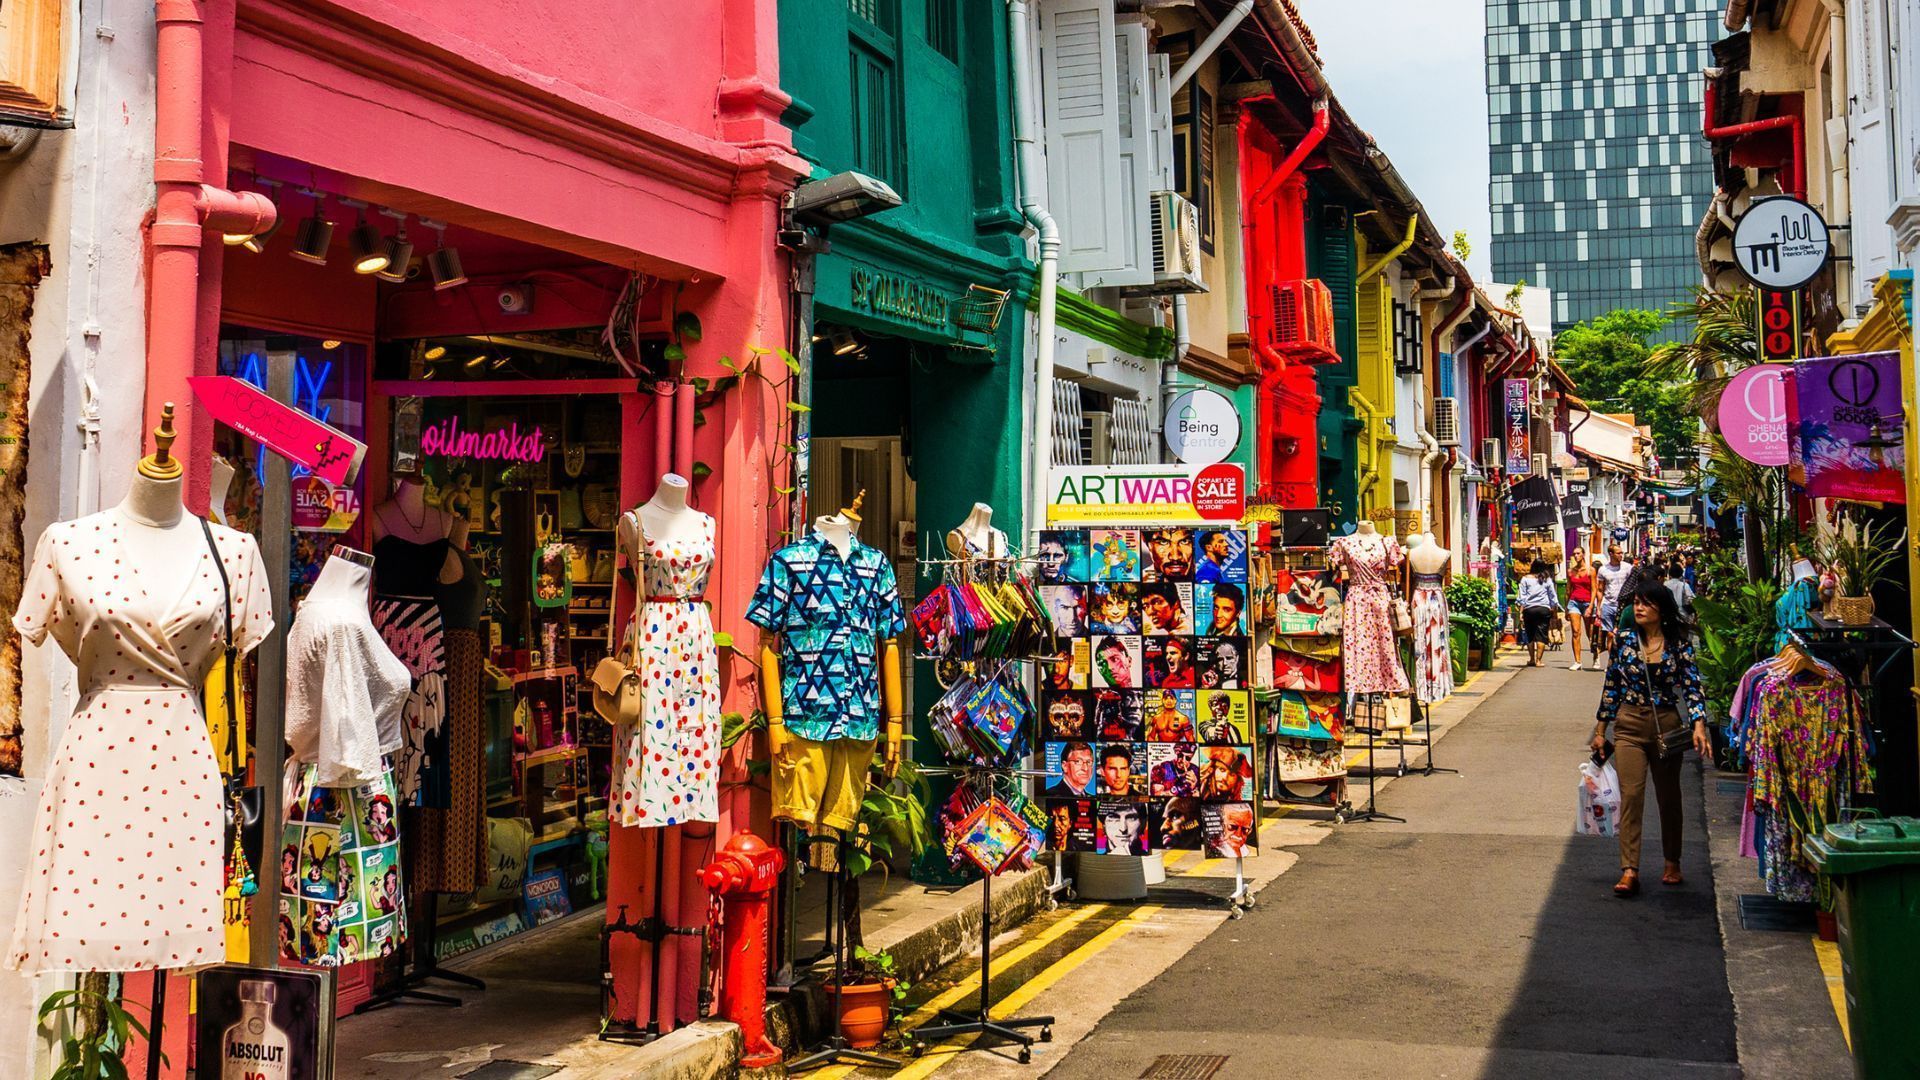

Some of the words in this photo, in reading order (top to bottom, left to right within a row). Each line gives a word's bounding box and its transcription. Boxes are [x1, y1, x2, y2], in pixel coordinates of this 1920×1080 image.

[1803, 249, 1823, 257] Design
[223, 385, 300, 440] HOOKED
[1179, 420, 1219, 436] Being
[255, 432, 268, 443] Lane
[421, 415, 545, 463] oilmarket
[1180, 435, 1226, 447] Centre
[1056, 475, 1191, 505] ARTWAR
[1197, 483, 1237, 497] SALE
[912, 593, 941, 621] Felix
[528, 879, 559, 896] MONOPOLY
[229, 1042, 284, 1062] ABSOLUT
